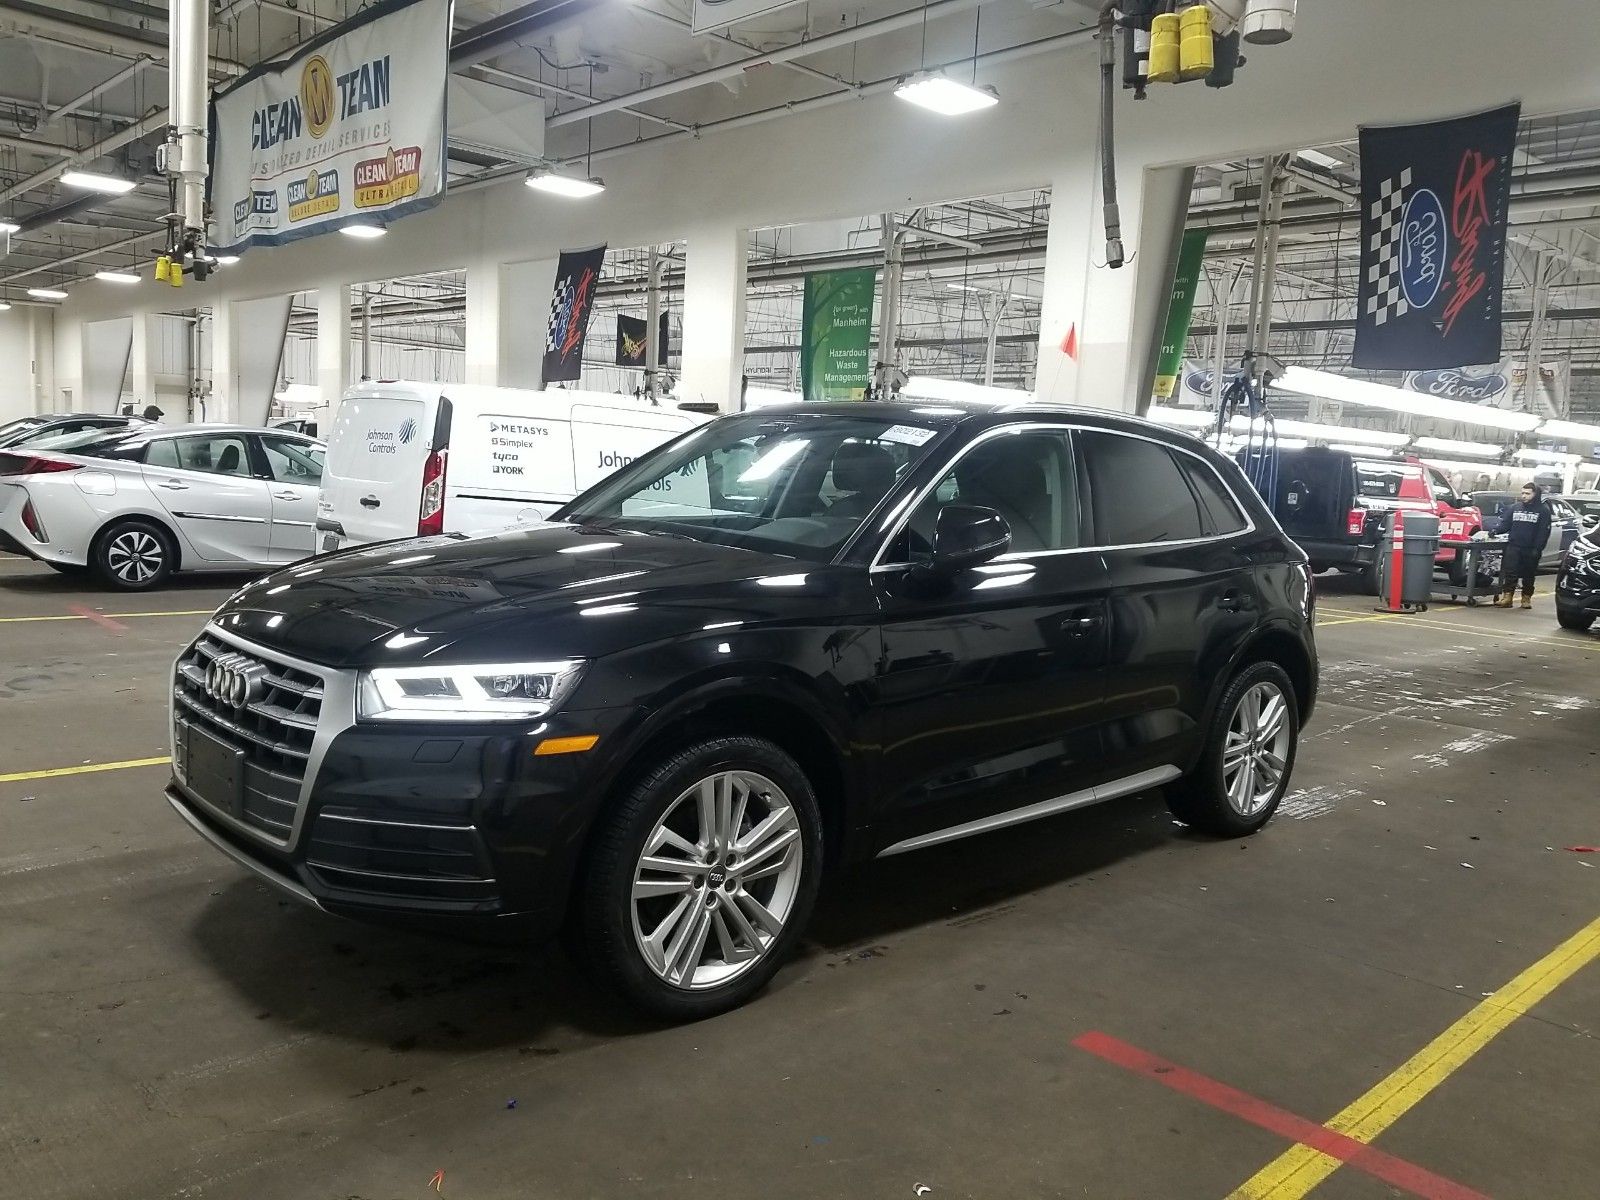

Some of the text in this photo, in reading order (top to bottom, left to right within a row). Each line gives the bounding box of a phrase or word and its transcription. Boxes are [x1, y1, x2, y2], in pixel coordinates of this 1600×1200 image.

[251, 96, 301, 151] CLEAN
[336, 55, 390, 121] TEAM
[356, 152, 417, 185] CLEAN TEAM
[288, 173, 337, 203] CLEAN TEAM
[833, 317, 867, 328] Manheim
[829, 348, 867, 358] Hazardous
[836, 360, 858, 369] Waste
[824, 373, 869, 383] Management
[1429, 371, 1491, 398] Ford
[366, 428, 394, 441] Johnson
[501, 424, 549, 436] METASYS
[368, 441, 396, 454] Controls
[499, 437, 533, 449] Simplex
[492, 451, 519, 462] tyco
[598, 451, 638, 468] John
[500, 465, 524, 475] YORK
